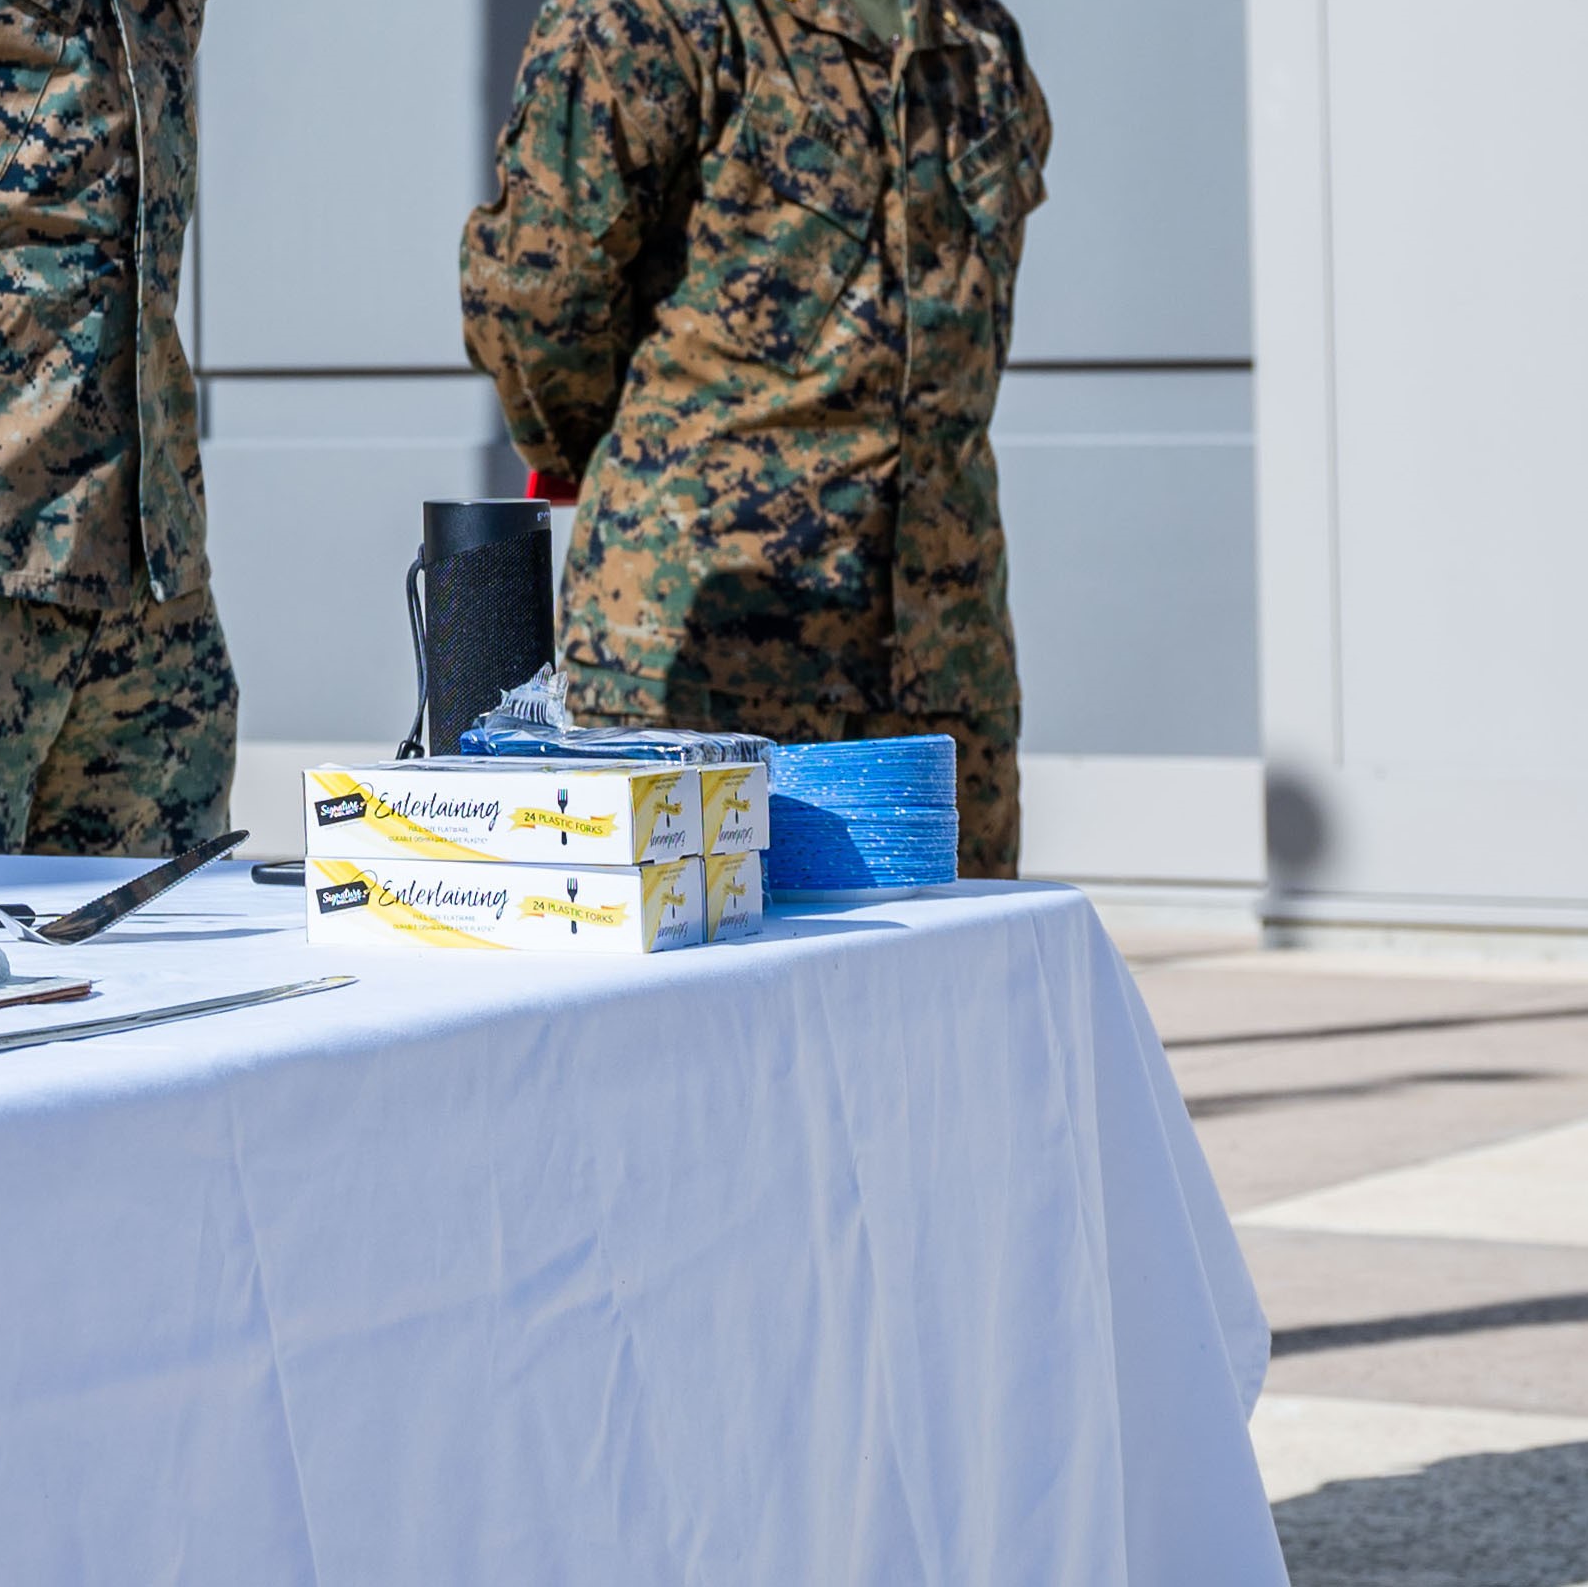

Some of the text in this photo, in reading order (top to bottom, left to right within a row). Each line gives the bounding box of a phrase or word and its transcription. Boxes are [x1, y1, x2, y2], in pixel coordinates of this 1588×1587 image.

[523, 812, 604, 835] 24 PLASTIC FORKS
[533, 900, 545, 911] 24
[547, 902, 584, 919] PLASTIC
